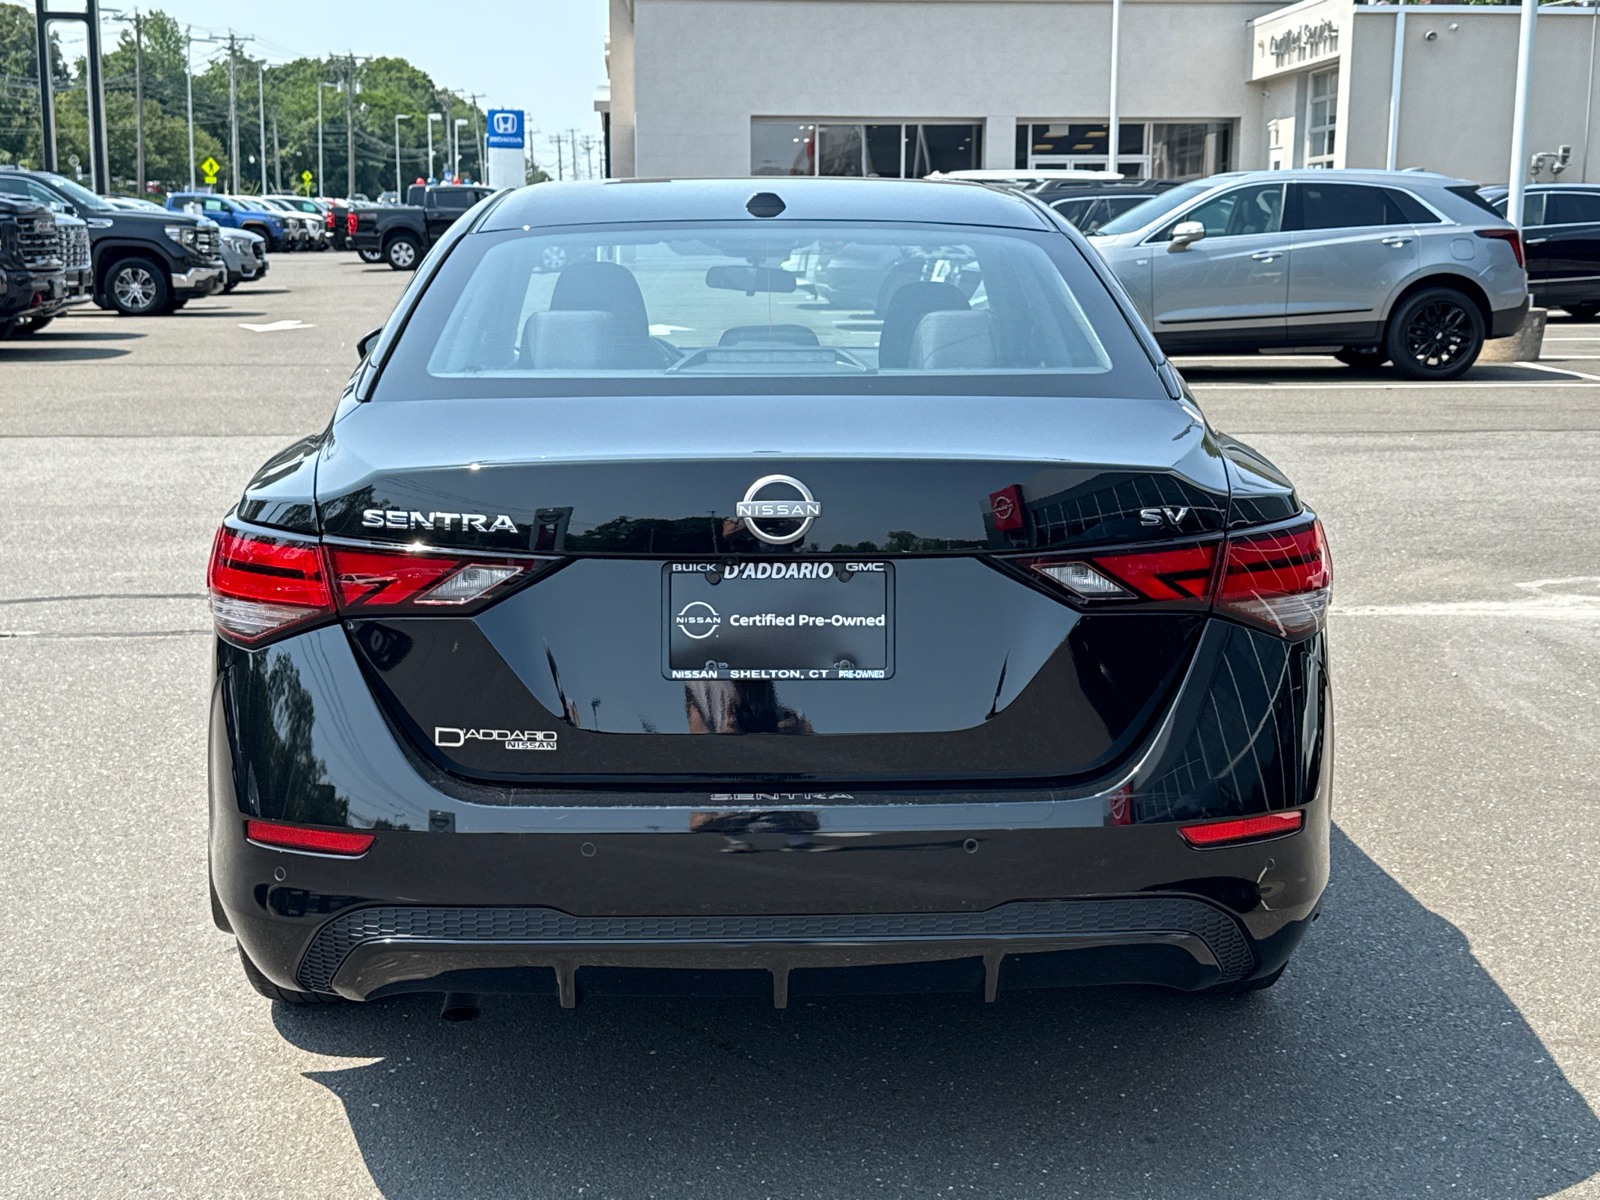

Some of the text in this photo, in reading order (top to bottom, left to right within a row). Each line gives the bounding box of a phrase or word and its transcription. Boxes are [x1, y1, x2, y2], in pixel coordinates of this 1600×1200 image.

[739, 504, 819, 516] NISSAN
[361, 509, 518, 534] SENTRA
[1140, 507, 1189, 526] SV
[672, 563, 717, 572] BUICK
[723, 562, 833, 580] D'ADDARIO
[845, 562, 885, 572] GMC
[676, 616, 721, 624] NISSAN
[729, 614, 885, 627] Certified Pre-Owned
[672, 670, 718, 679] NISSAN
[729, 669, 830, 680] SHELTON, CT
[838, 669, 885, 679] PRE-OWNED
[434, 726, 558, 748] D'ADDARIO
[506, 741, 557, 750] NISSAN
[710, 793, 855, 801] SENTRA
